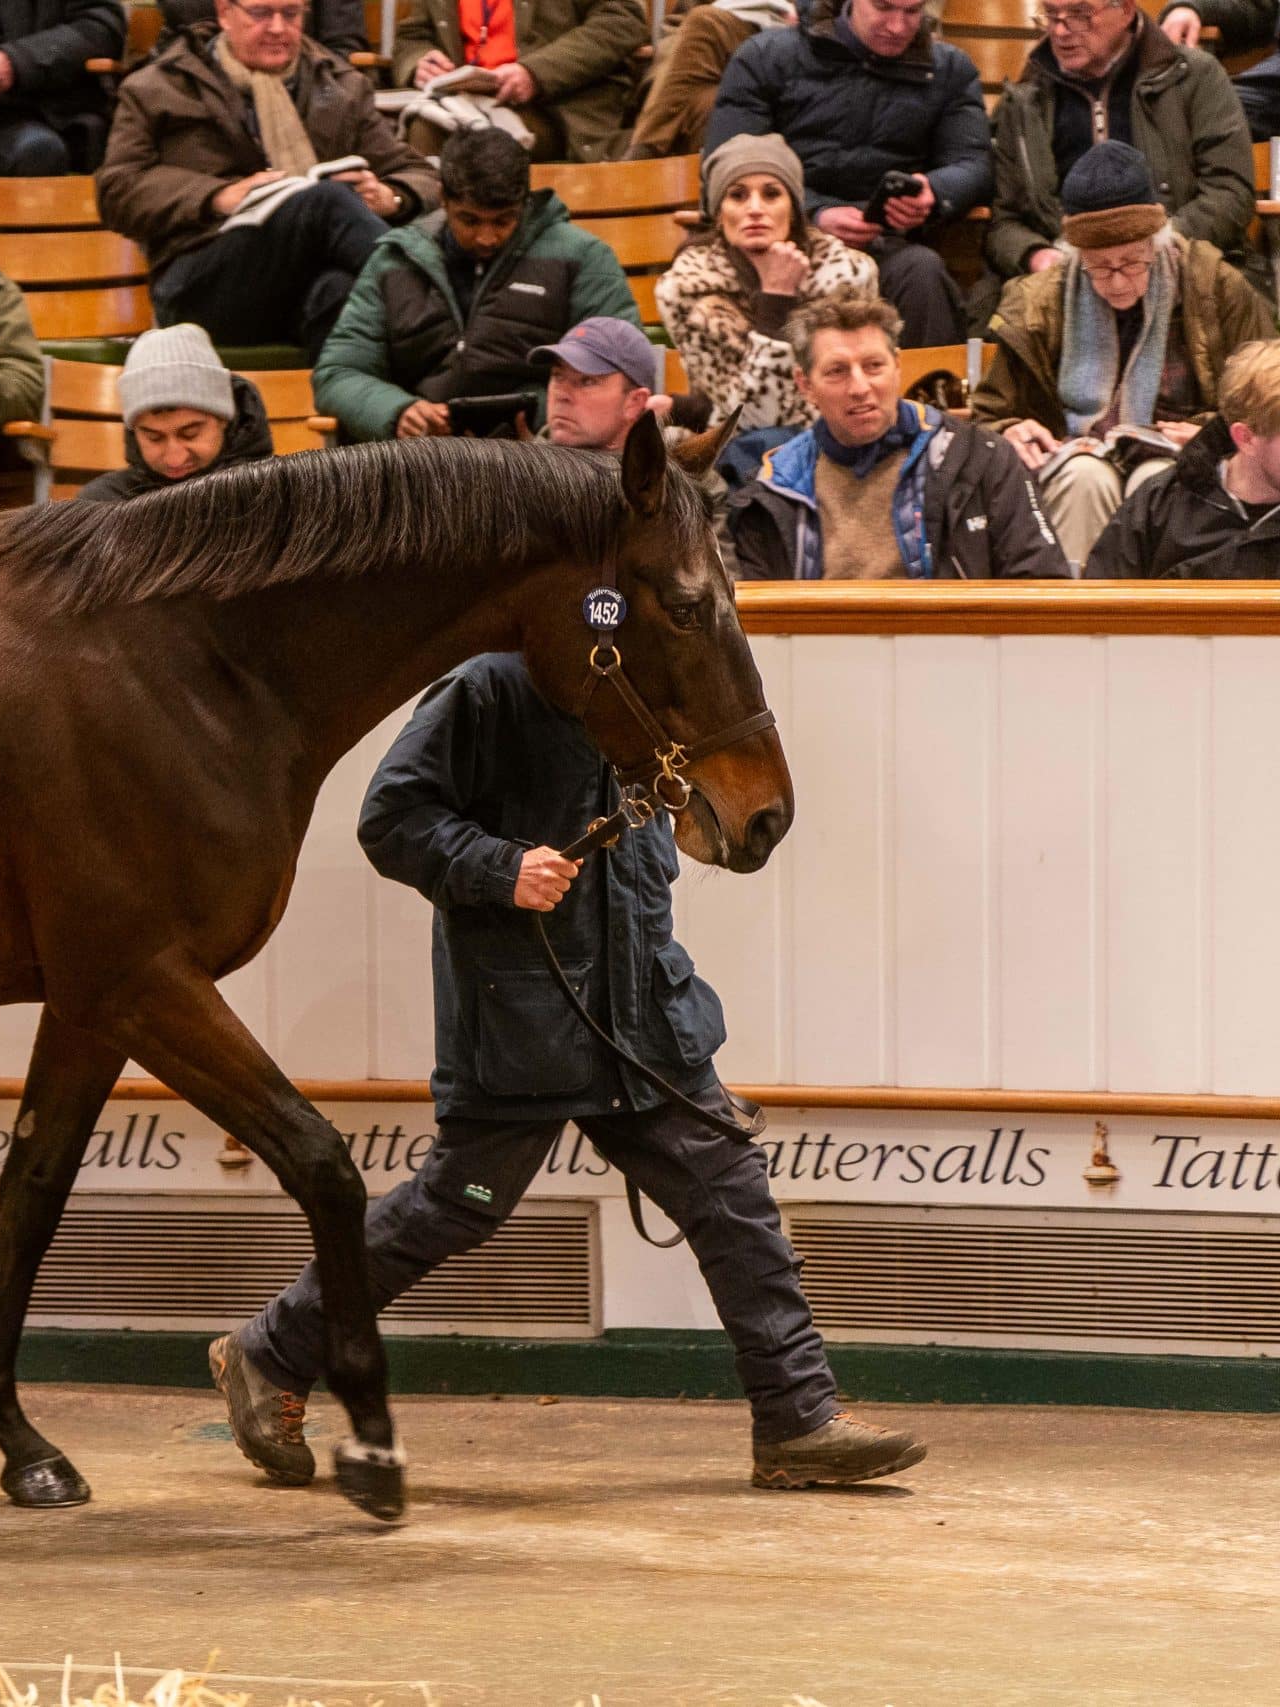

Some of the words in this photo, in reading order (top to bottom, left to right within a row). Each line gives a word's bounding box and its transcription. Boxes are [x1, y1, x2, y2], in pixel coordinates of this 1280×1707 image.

[588, 601, 619, 625] 1452
[760, 1127, 1051, 1187] attersalls
[1150, 1135, 1280, 1191] Tatt
